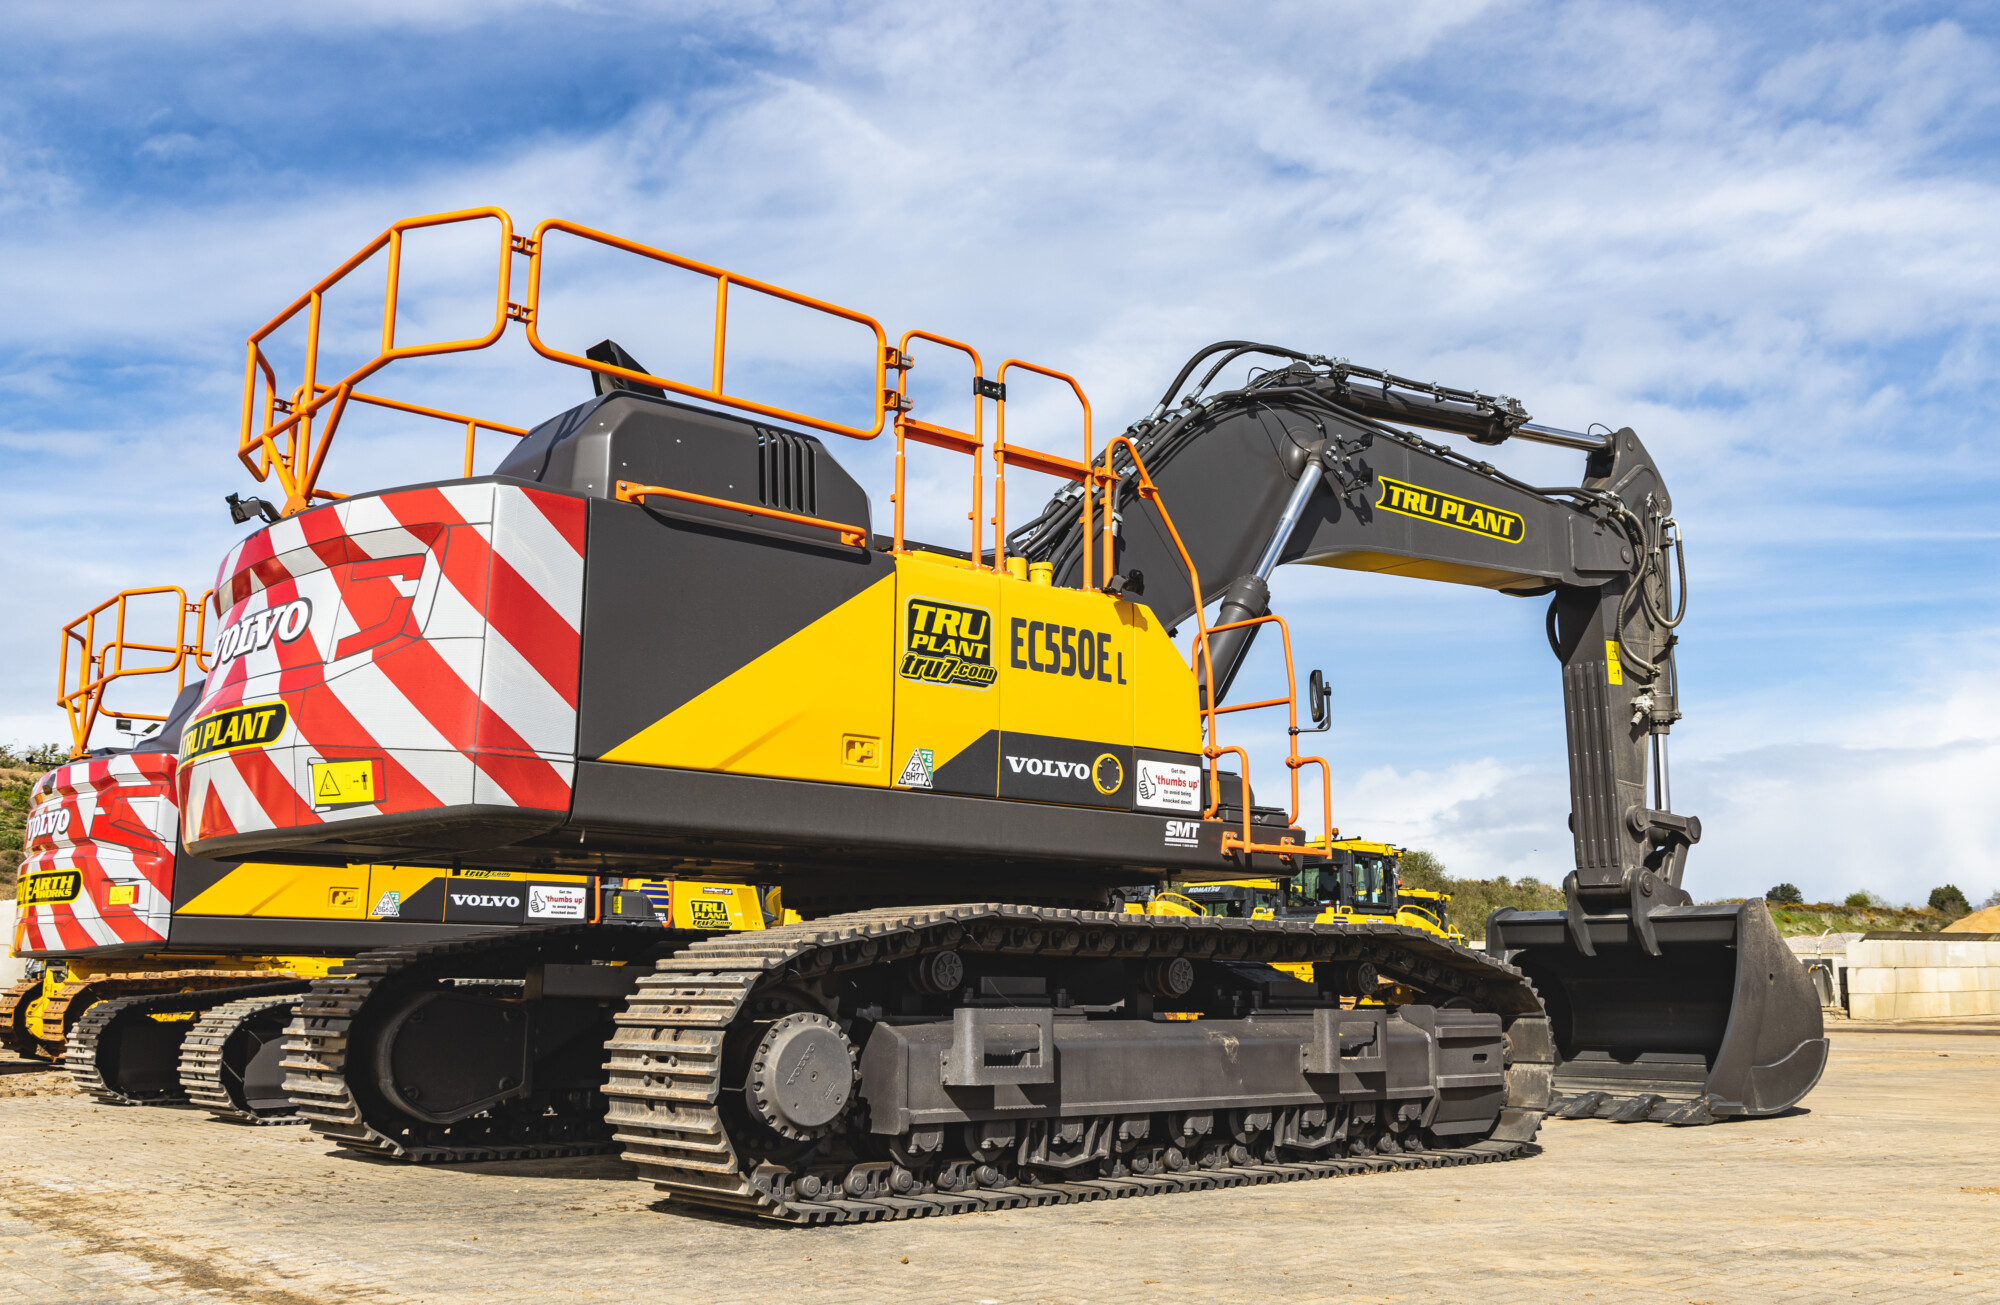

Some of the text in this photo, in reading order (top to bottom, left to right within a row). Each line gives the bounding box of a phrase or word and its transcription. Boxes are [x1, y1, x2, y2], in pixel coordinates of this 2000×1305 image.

[1389, 485, 1515, 536] TRU PLANT
[211, 597, 312, 671] VOLVO
[911, 604, 988, 640] TRU
[910, 633, 988, 659] PLANT
[1010, 617, 1127, 685] EC550E L
[899, 652, 997, 684] tru7.com
[202, 710, 276, 750] PLANT
[911, 762, 921, 772] 27
[1005, 755, 1091, 780] VOLVO
[27, 807, 71, 841] VOLVO
[1165, 820, 1200, 838] SMT
[450, 893, 520, 908] VOLVO
[1188, 885, 1221, 894] KOMATSU
[691, 901, 724, 913] TRU
